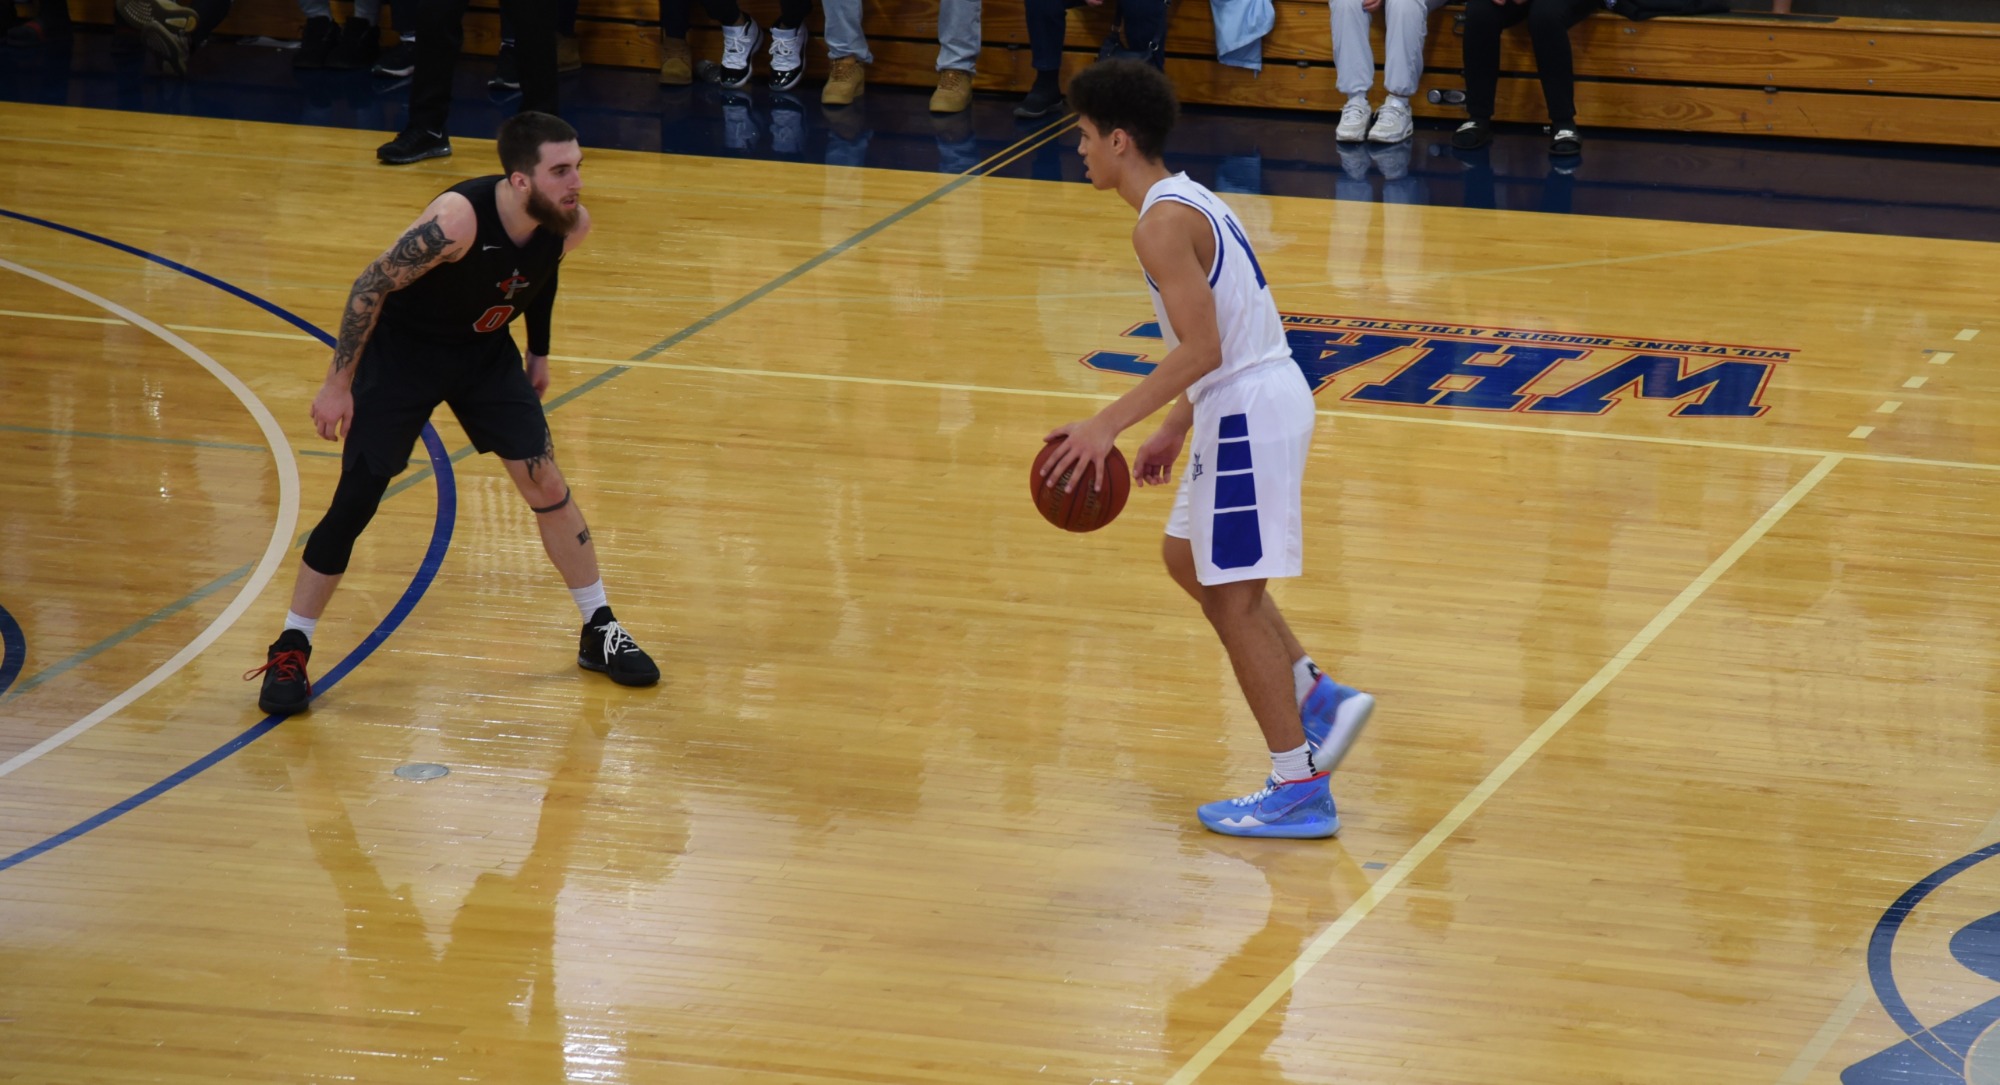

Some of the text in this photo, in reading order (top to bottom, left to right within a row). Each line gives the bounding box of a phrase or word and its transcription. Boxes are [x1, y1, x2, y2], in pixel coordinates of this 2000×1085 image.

[472, 305, 515, 333] 0
[1347, 320, 1486, 337] ATHLETIC
[1492, 330, 1791, 360] WOLVERINE-HOOSIER
